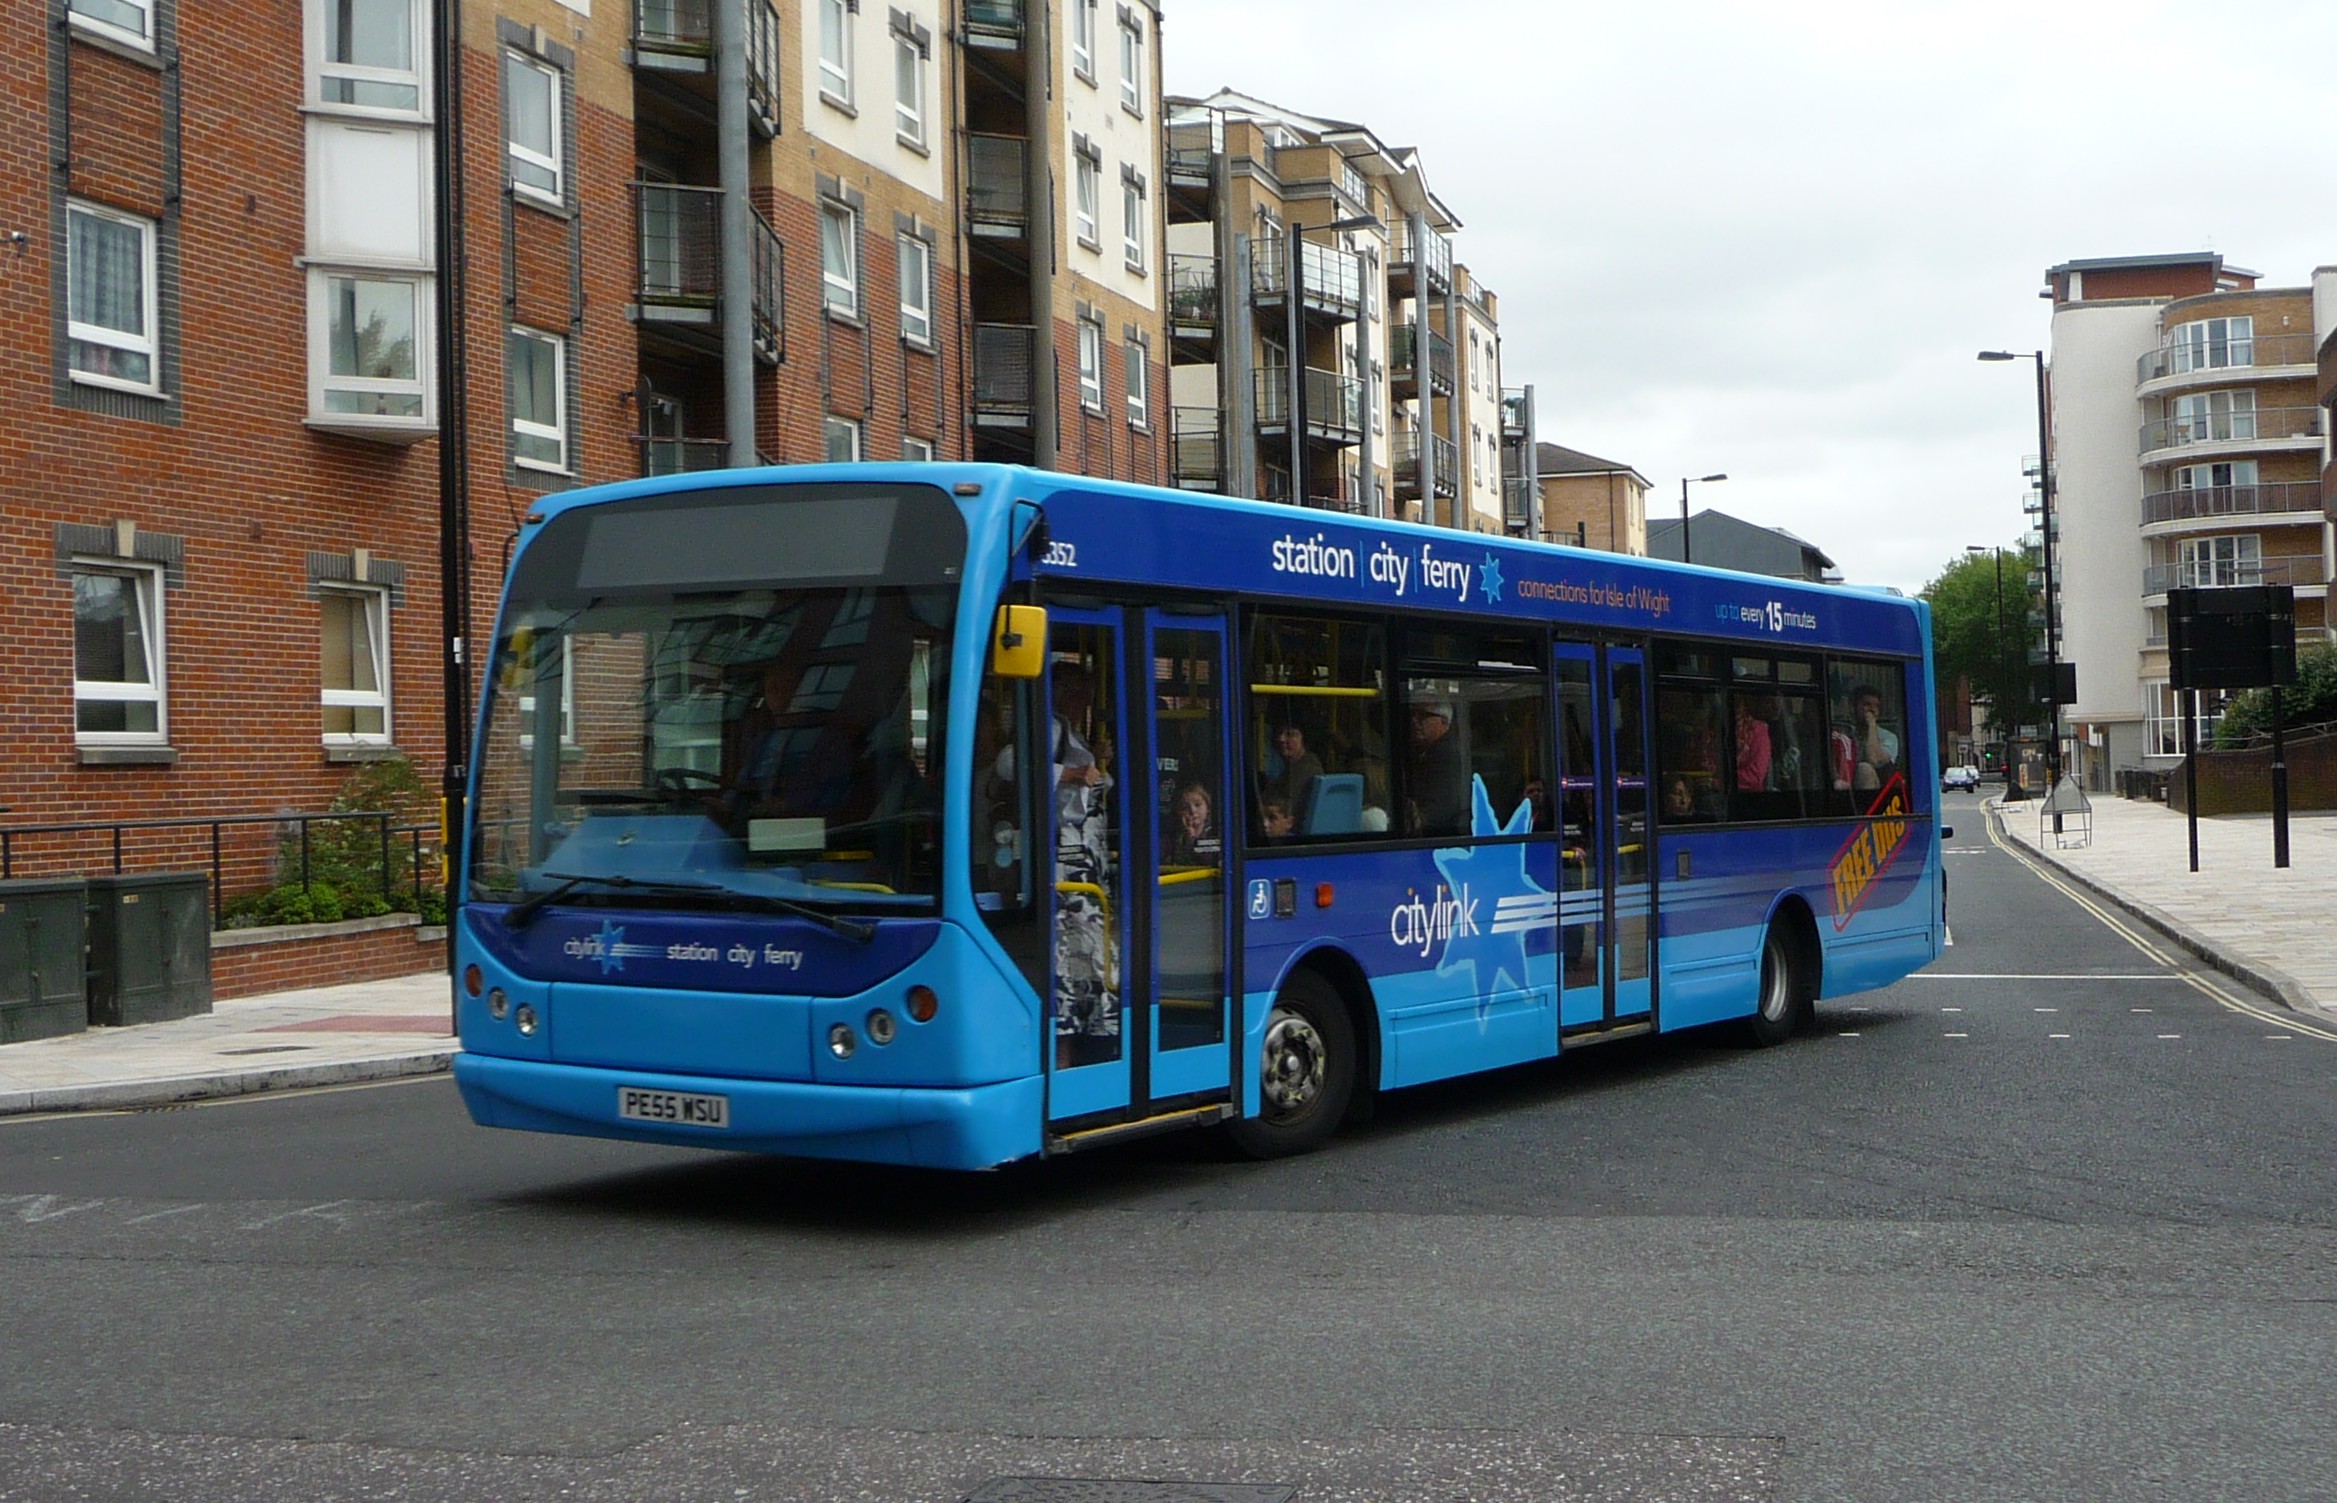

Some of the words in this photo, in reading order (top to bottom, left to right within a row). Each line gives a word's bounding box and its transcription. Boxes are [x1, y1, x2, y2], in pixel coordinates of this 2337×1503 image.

[1272, 532, 1354, 579] station
[1369, 541, 1409, 597] city
[1421, 543, 1471, 603] ferry
[1517, 578, 1588, 605] connections
[1589, 580, 1606, 606] for
[1605, 582, 1624, 608] Isle
[1626, 585, 1638, 609] of
[1637, 587, 1671, 619] Wight
[1714, 603, 1729, 624] up
[1728, 602, 1740, 621] to
[1740, 606, 1765, 630] every
[1765, 600, 1783, 632] 15
[1783, 606, 1817, 630] minutes
[1832, 827, 1875, 916] FREE
[1391, 882, 1480, 958] citylink
[563, 936, 606, 960] citylink
[667, 941, 719, 961] station
[727, 943, 756, 968] city
[764, 944, 803, 971] ferry
[626, 1091, 677, 1119] PE55
[682, 1097, 721, 1123] WSU
